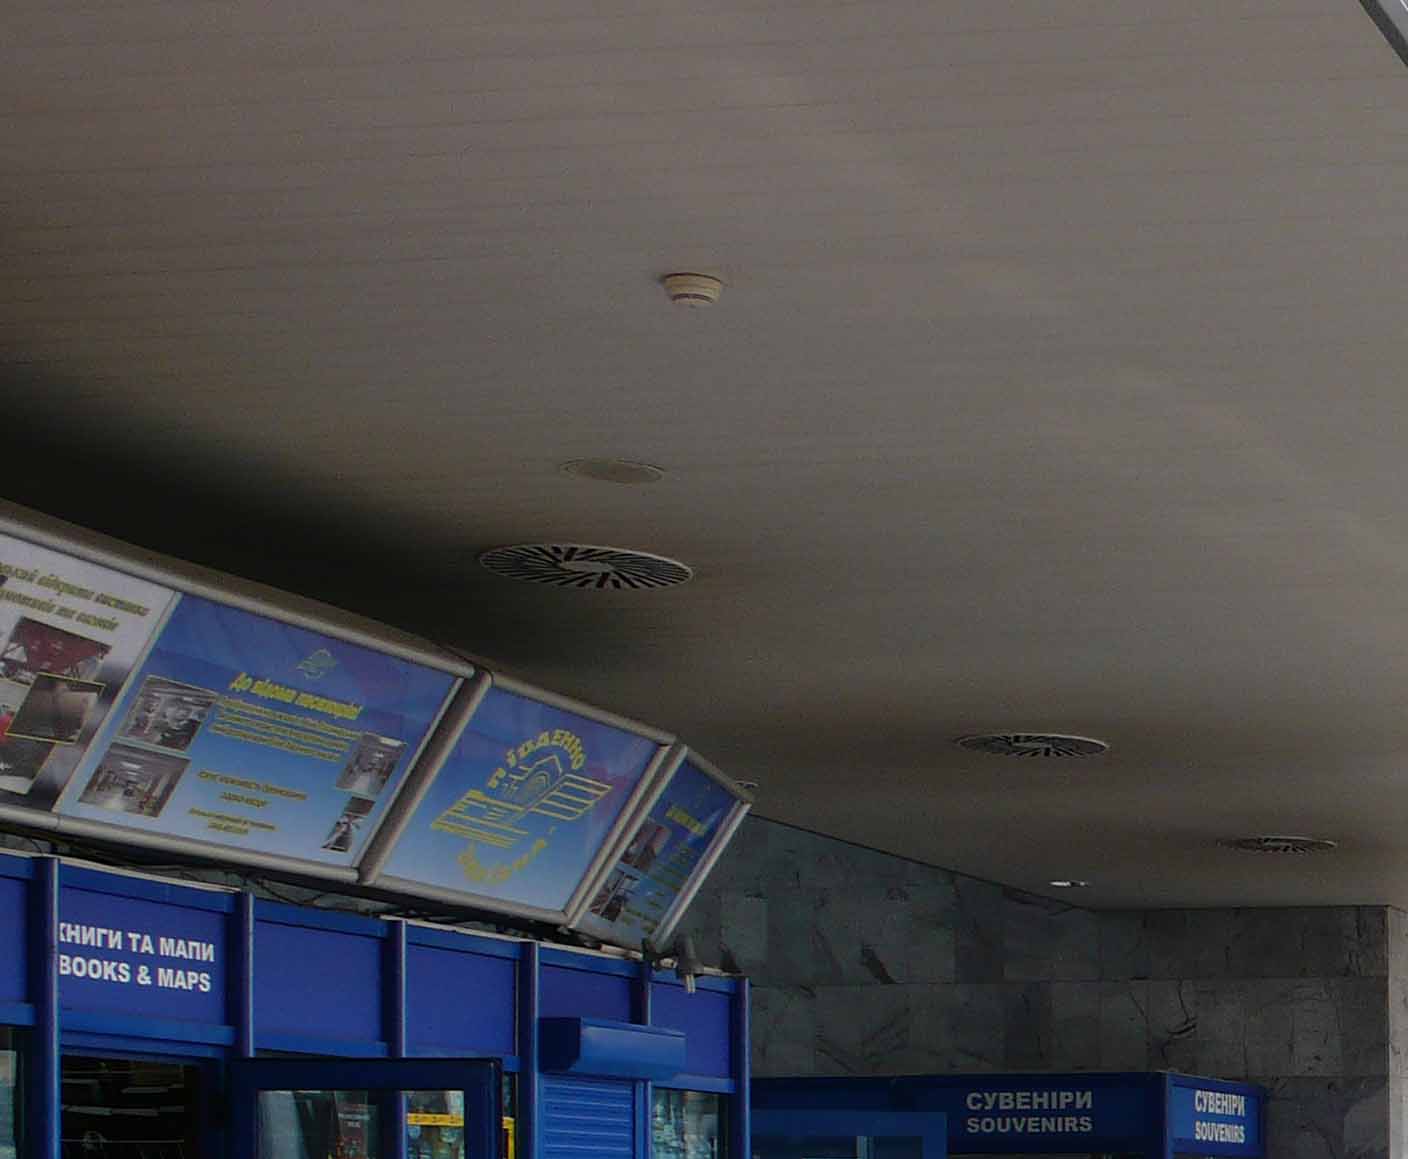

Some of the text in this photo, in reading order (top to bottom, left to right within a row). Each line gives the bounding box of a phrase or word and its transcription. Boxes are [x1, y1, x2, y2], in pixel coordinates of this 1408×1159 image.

[128, 932, 155, 955] ТА
[159, 937, 215, 963] МАПИ
[59, 954, 211, 993] BOOKS & MAPS
[966, 1091, 1093, 1111] СУВЕНІРИ
[1195, 1090, 1245, 1117] СУВЕНІРИ
[966, 1115, 1093, 1133] SOUVENIRS
[1195, 1121, 1245, 1144] SOUVENIRS
